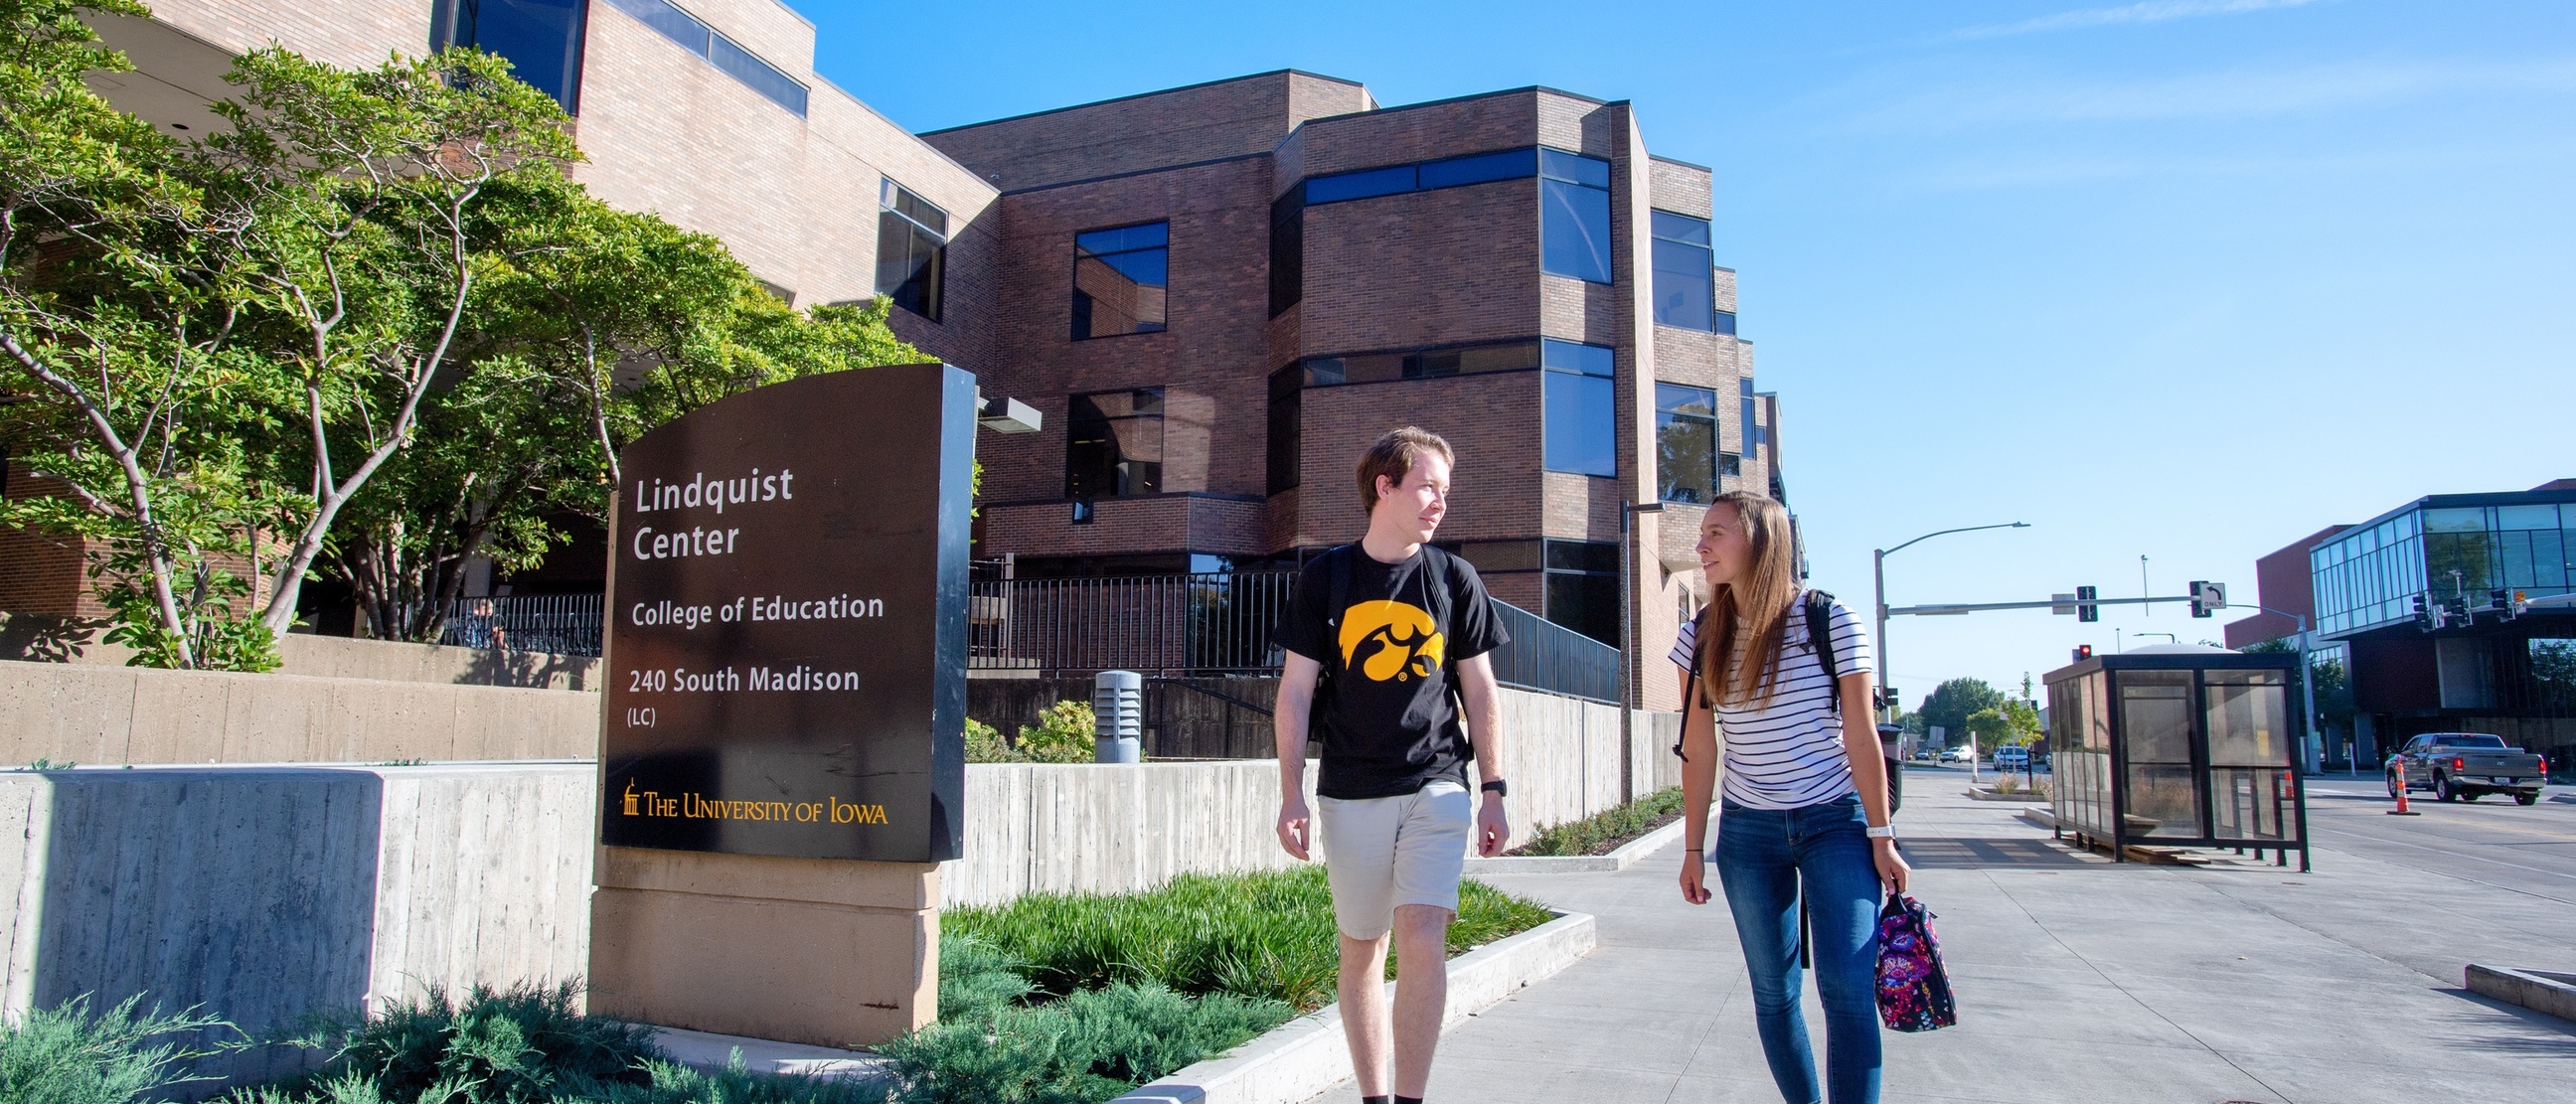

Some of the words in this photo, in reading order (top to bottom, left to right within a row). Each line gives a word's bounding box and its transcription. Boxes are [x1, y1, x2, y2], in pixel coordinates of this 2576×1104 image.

[636, 467, 794, 515] Lindquist
[633, 526, 739, 560] Center
[631, 600, 713, 630] College
[720, 596, 745, 622] of
[752, 593, 884, 621] Education
[629, 669, 667, 693] 240
[673, 666, 739, 693] South
[748, 665, 859, 692] Madison
[627, 707, 656, 728] (LC)
